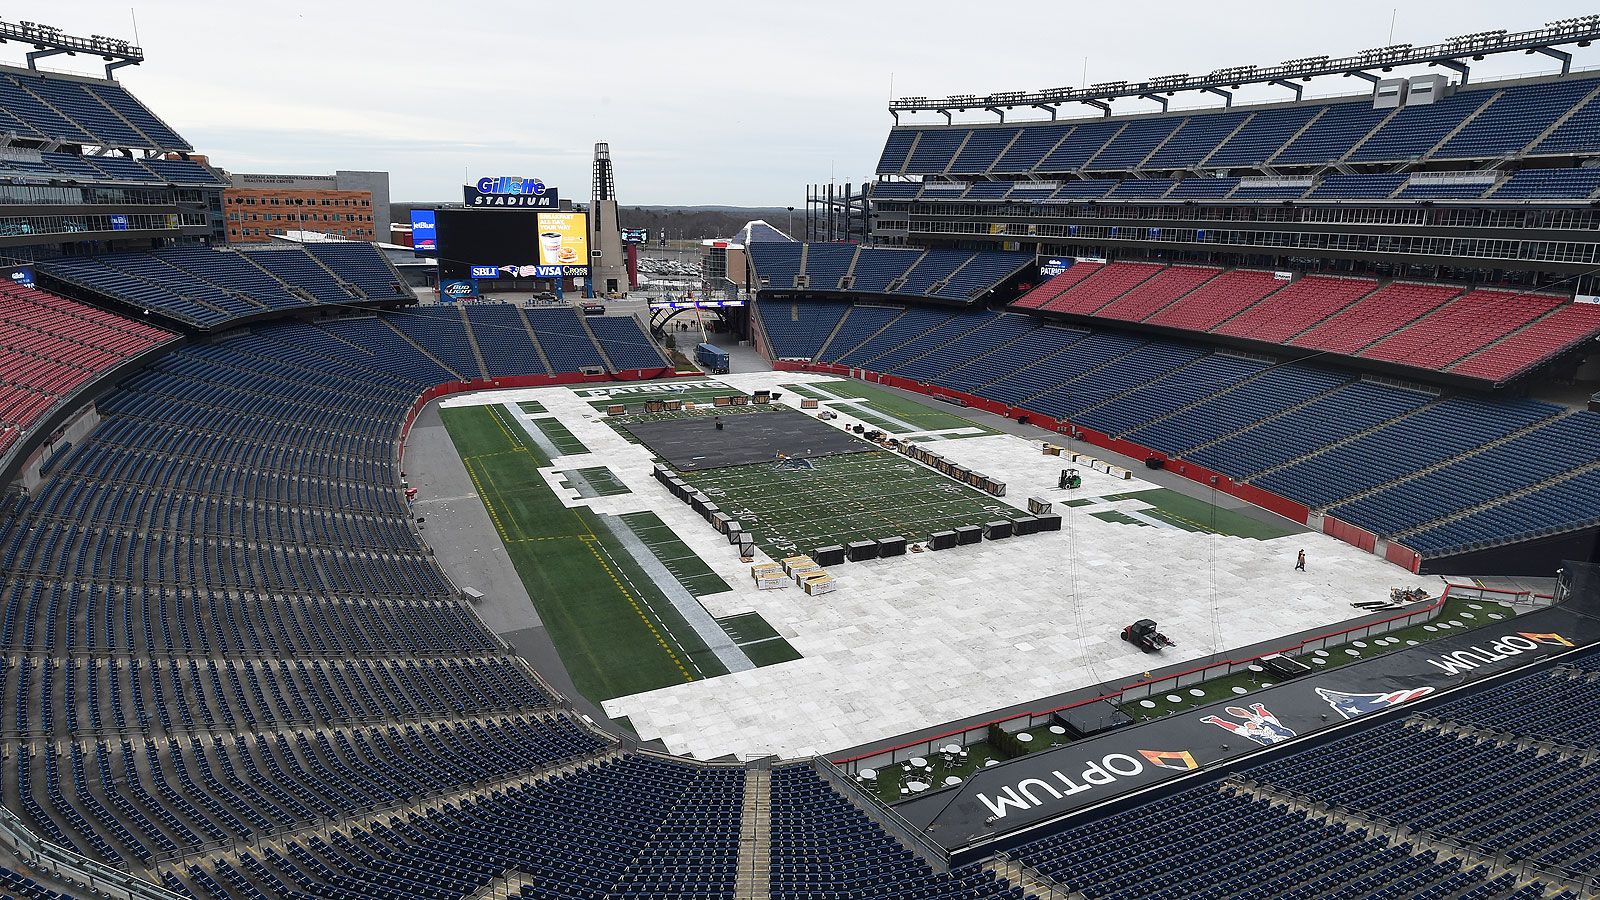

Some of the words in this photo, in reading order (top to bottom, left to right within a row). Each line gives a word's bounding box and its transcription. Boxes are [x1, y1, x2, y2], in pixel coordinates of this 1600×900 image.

[477, 176, 546, 195] Gillette
[474, 196, 550, 206] STADIUM
[472, 267, 497, 276] SBLI
[537, 266, 561, 275] VISA
[1040, 266, 1067, 276] PATRIOT
[586, 382, 730, 397] PATRIOTS
[1426, 635, 1538, 675] OPTUM
[976, 752, 1145, 819] OPTUM
